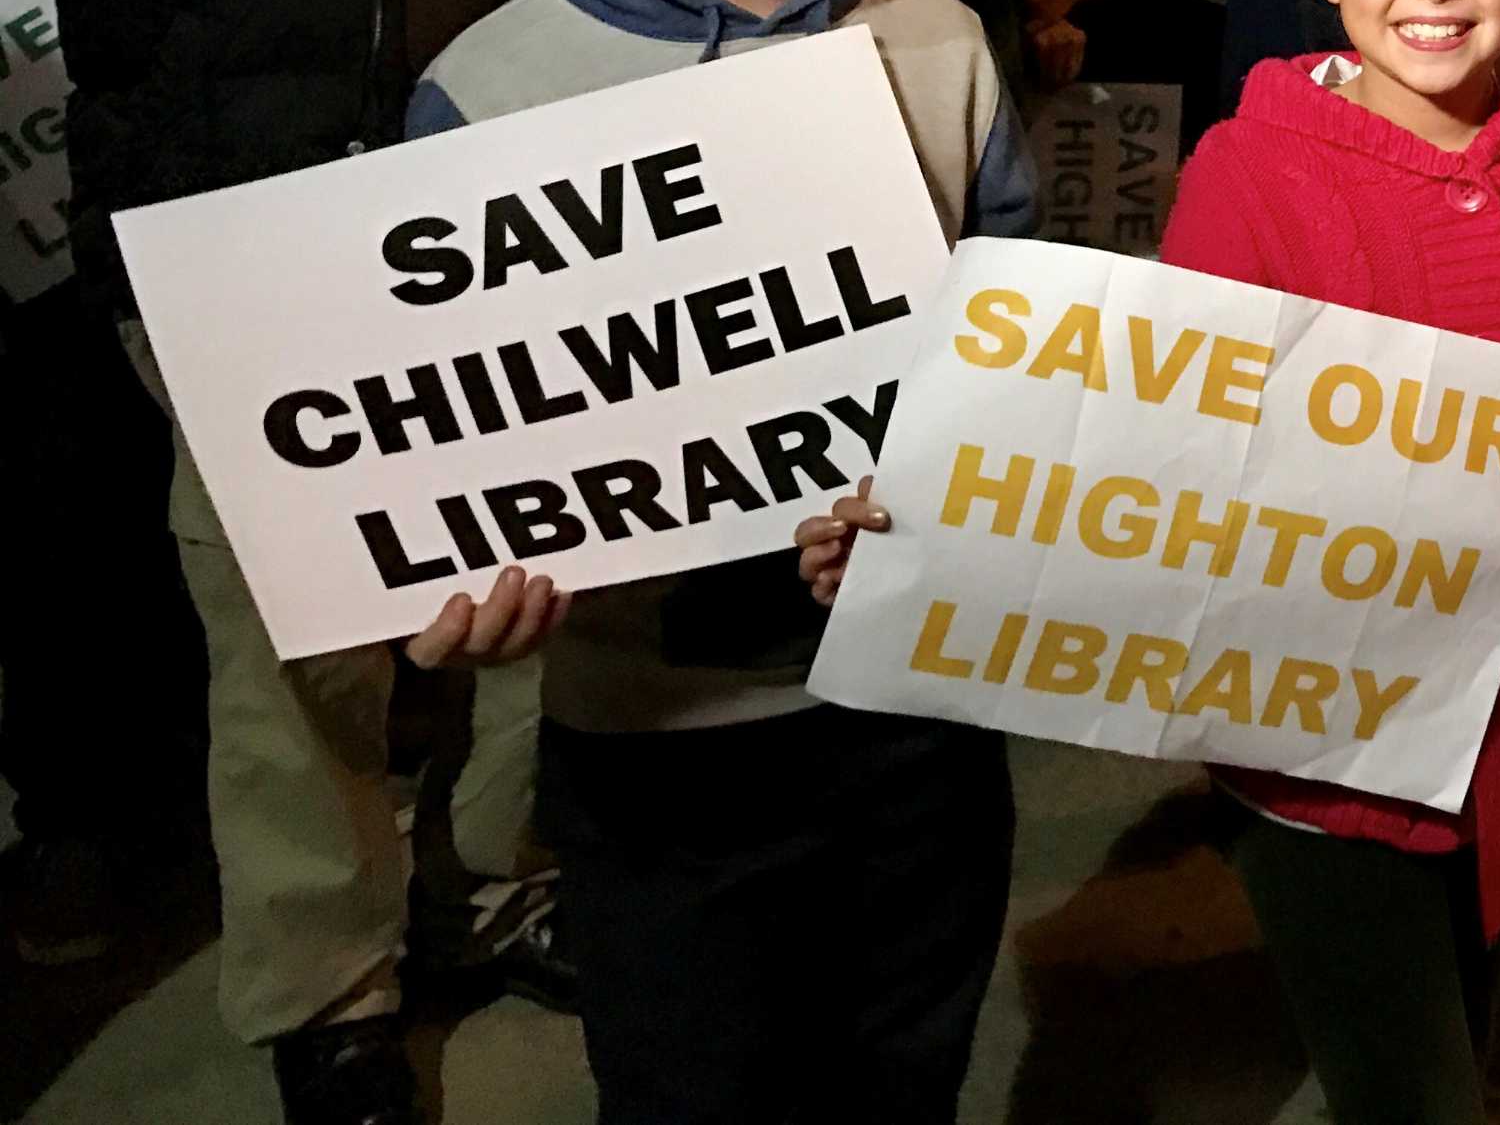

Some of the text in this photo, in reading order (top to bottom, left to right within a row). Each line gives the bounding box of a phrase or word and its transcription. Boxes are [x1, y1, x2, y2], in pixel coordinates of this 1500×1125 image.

[382, 142, 723, 307] SAVE
[1051, 120, 1095, 244] HIGH
[262, 245, 912, 468] CHILWELL
[953, 288, 1276, 427] SAVE
[355, 379, 901, 590] LIBRARY
[939, 443, 1481, 616] HIGHTON
[909, 599, 1420, 742] LIBRARY
